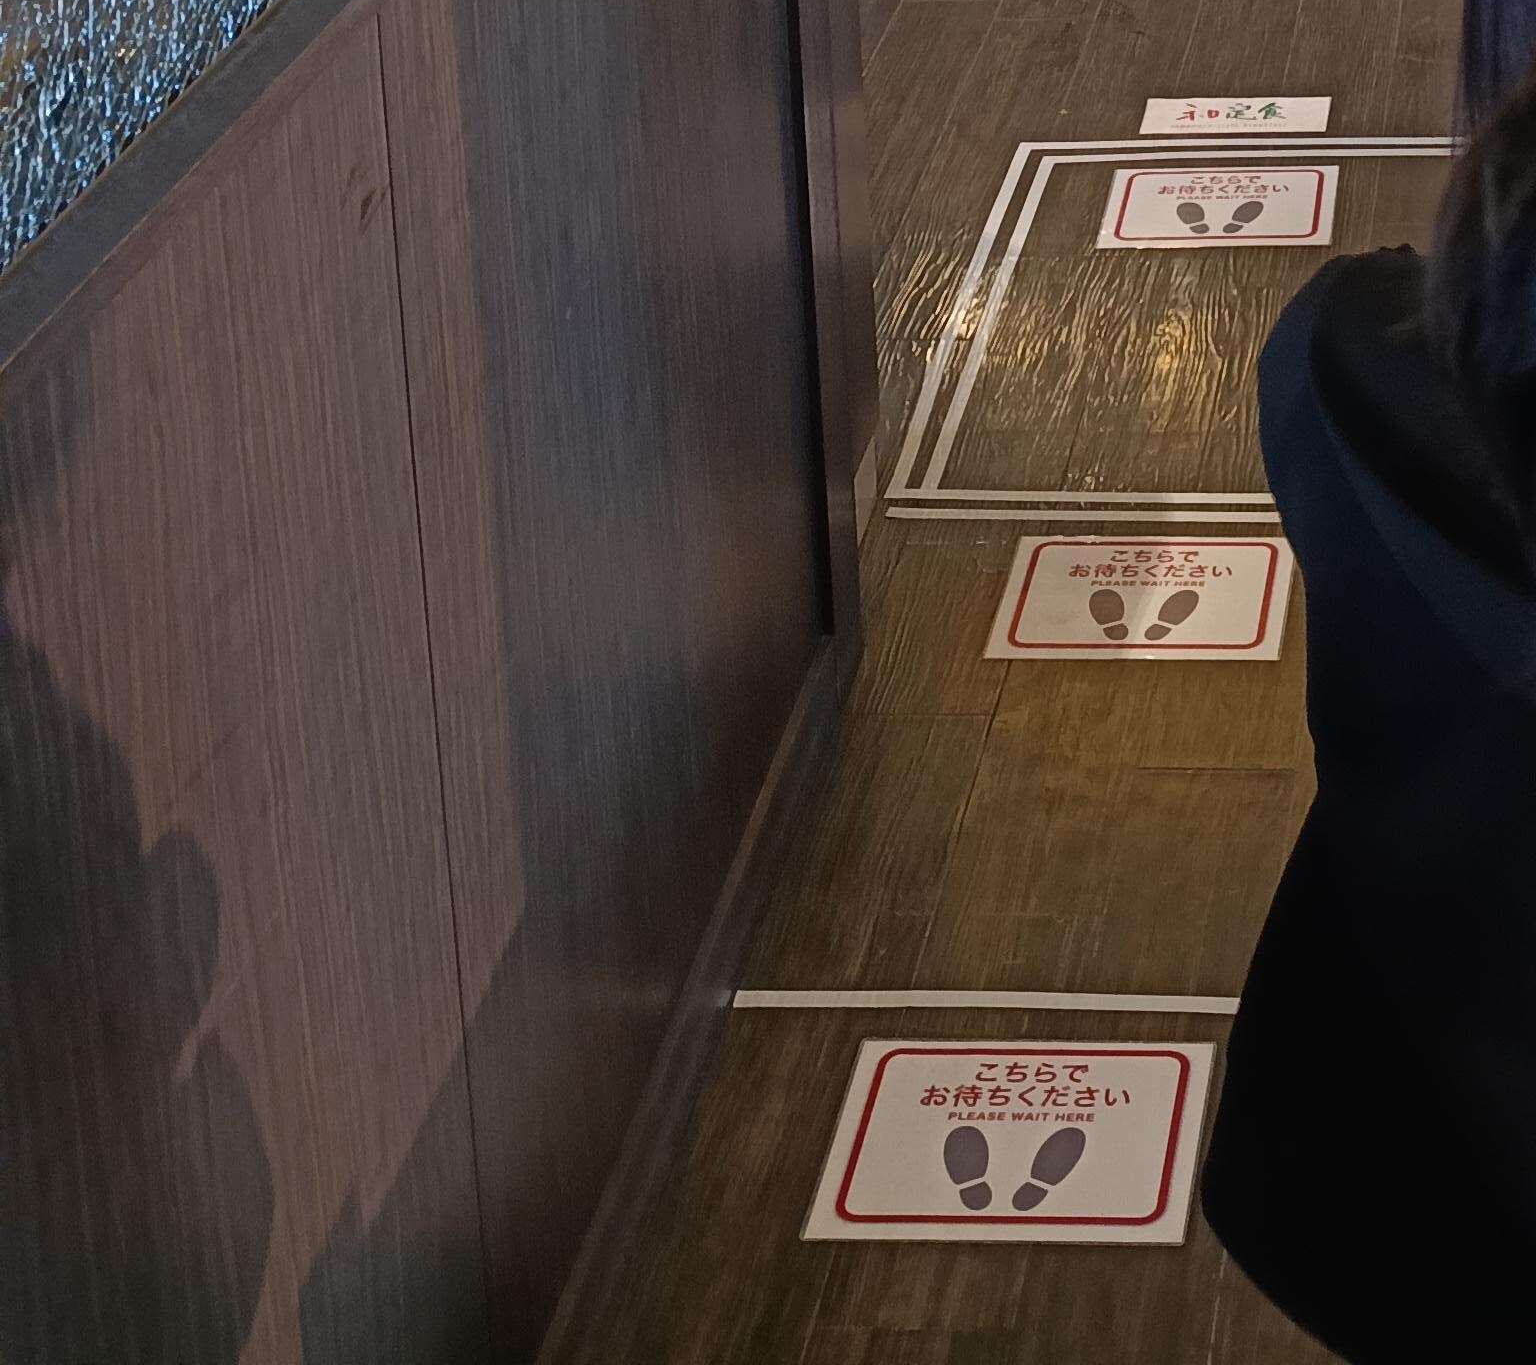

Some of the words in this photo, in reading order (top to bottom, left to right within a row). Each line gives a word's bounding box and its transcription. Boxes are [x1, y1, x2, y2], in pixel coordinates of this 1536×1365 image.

[1176, 102, 1287, 121] 和定食
[1190, 175, 1262, 185] こちらで
[1157, 184, 1289, 195] お待ちください
[1110, 549, 1199, 563] こちらで
[1068, 563, 1233, 578] お待ちください
[975, 1062, 1089, 1083] こちらで
[919, 1084, 1131, 1108] お待ちください
[947, 1111, 1007, 1121] PLEASE
[1011, 1112, 1050, 1122] WAIT
[1055, 1112, 1095, 1123] HERE
